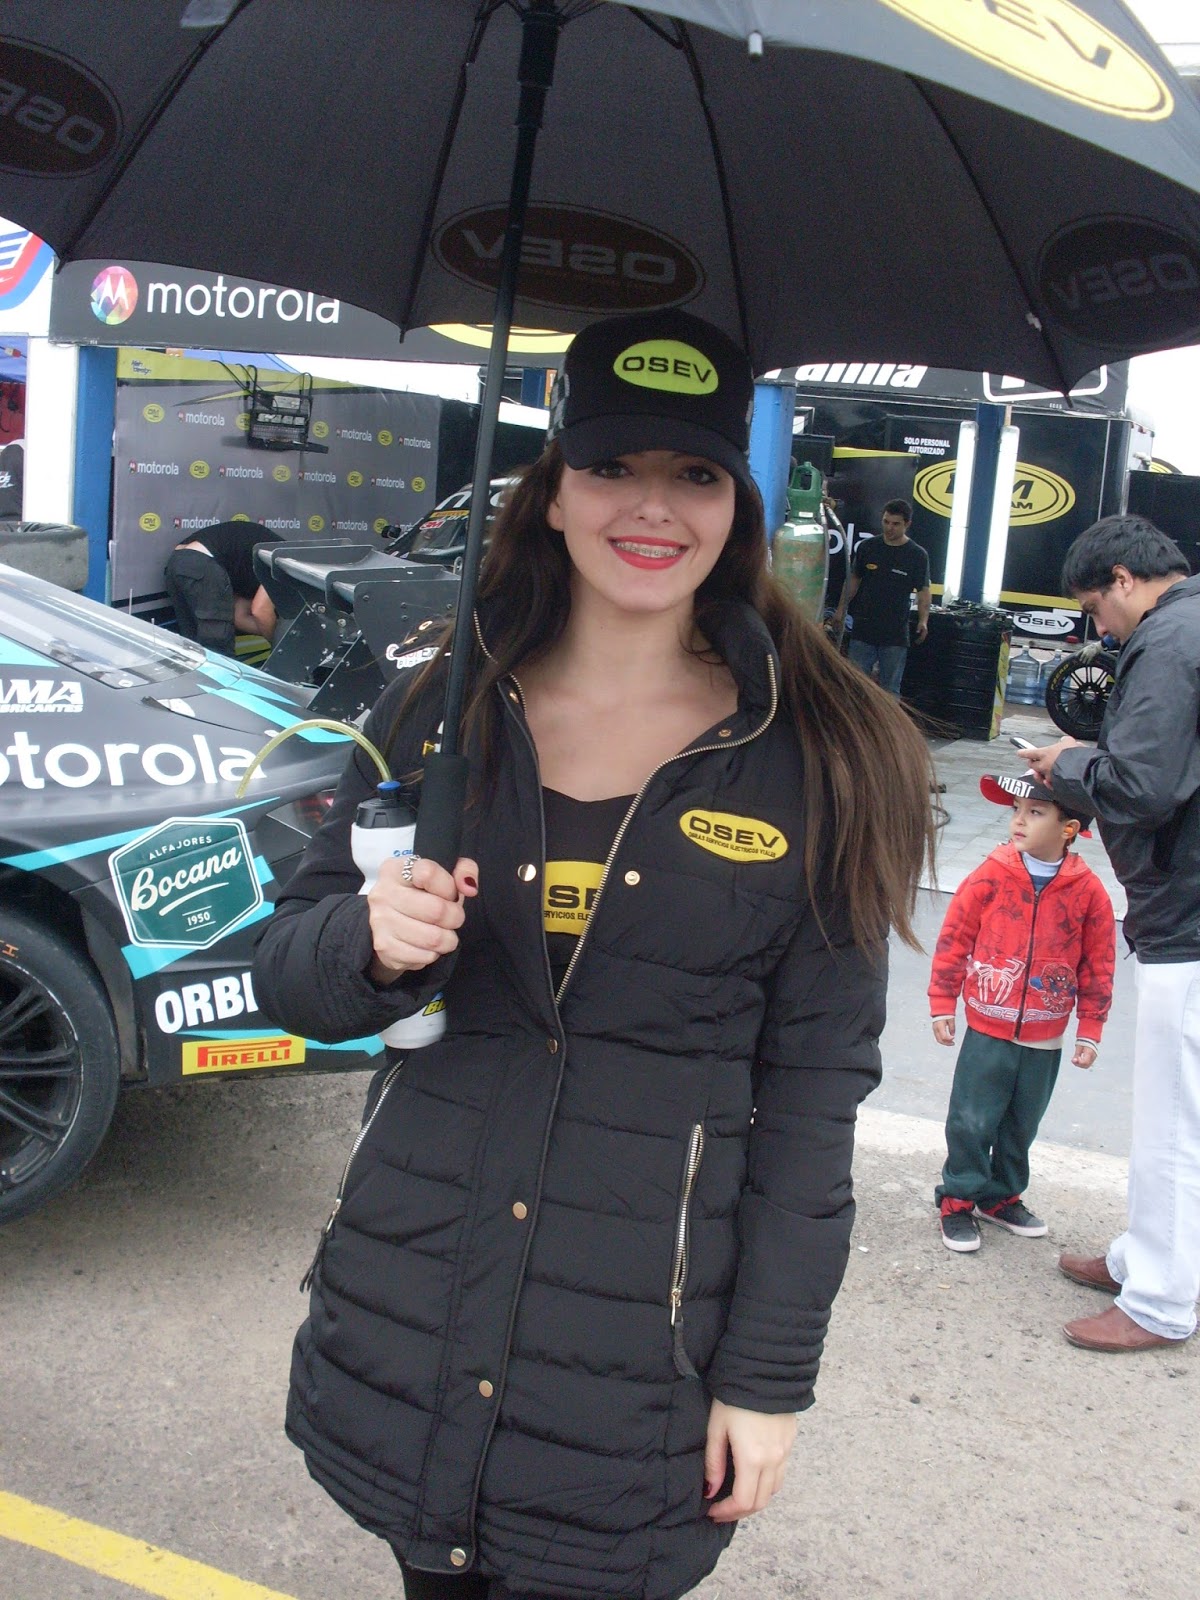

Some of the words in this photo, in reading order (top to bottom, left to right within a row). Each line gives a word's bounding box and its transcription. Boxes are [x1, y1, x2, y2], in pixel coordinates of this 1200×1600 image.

[147, 275, 341, 324] motorola
[622, 356, 712, 383] OSEV
[185, 412, 225, 426] motorola
[341, 429, 372, 442] motorola
[903, 436, 920, 445] SOLO
[920, 438, 951, 448] PERSONAL
[403, 437, 431, 449] motorola
[908, 446, 945, 456] AUTORIZADO
[137, 461, 179, 475] motorola
[226, 466, 264, 479] motorola
[303, 471, 337, 484] motorola
[375, 477, 405, 489] motorola
[265, 517, 300, 529] motorola
[336, 520, 368, 531] motorola
[1017, 615, 1069, 628] OSEV
[0, 731, 268, 790] torola
[689, 815, 780, 849] OSEV
[149, 835, 213, 861] ALFAJORES
[131, 846, 242, 912] Bocana
[187, 912, 211, 926] 1950
[155, 972, 259, 1035] ORBI
[197, 1039, 293, 1069] PIRELLI
